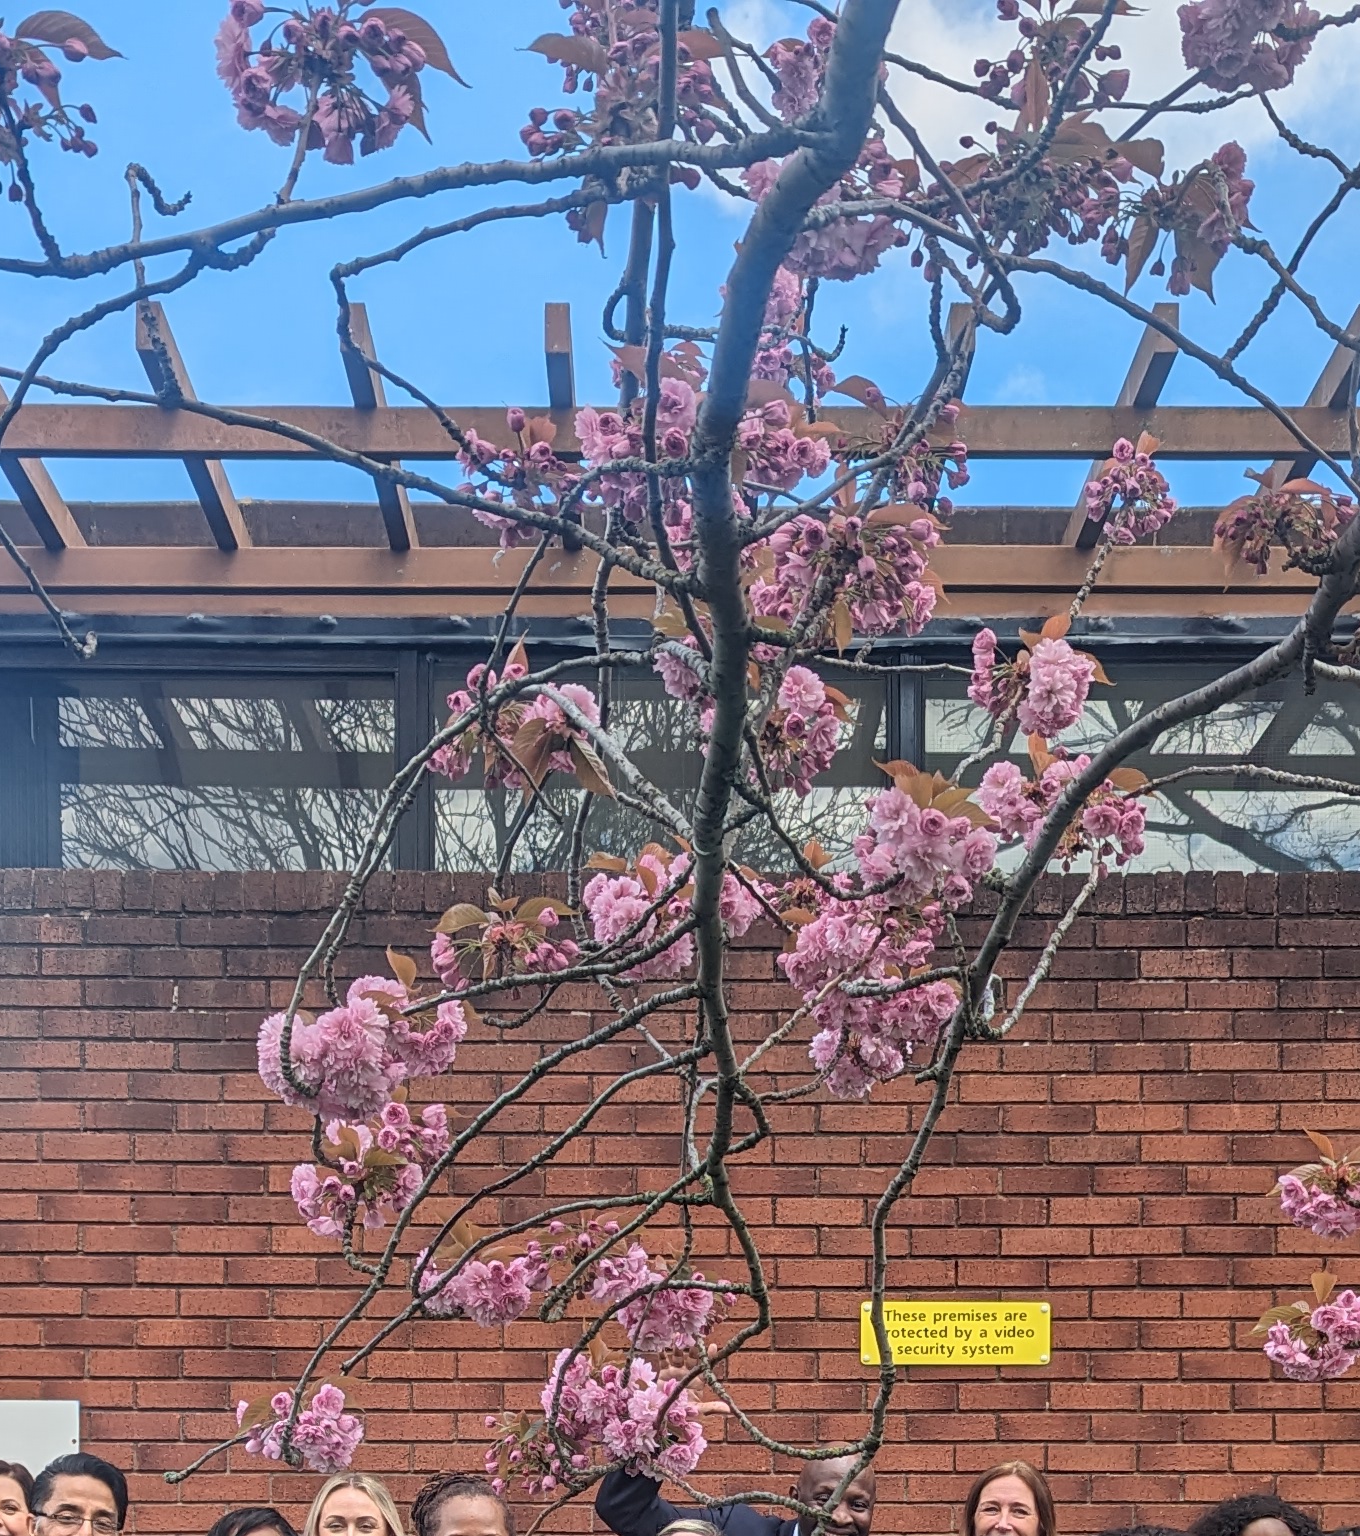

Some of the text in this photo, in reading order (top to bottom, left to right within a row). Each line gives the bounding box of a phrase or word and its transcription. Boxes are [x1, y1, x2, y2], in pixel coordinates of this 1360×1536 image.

[884, 1309, 1028, 1325] These premises are
[881, 1325, 1035, 1342] rotected by a video
[897, 1342, 1014, 1358] security system
